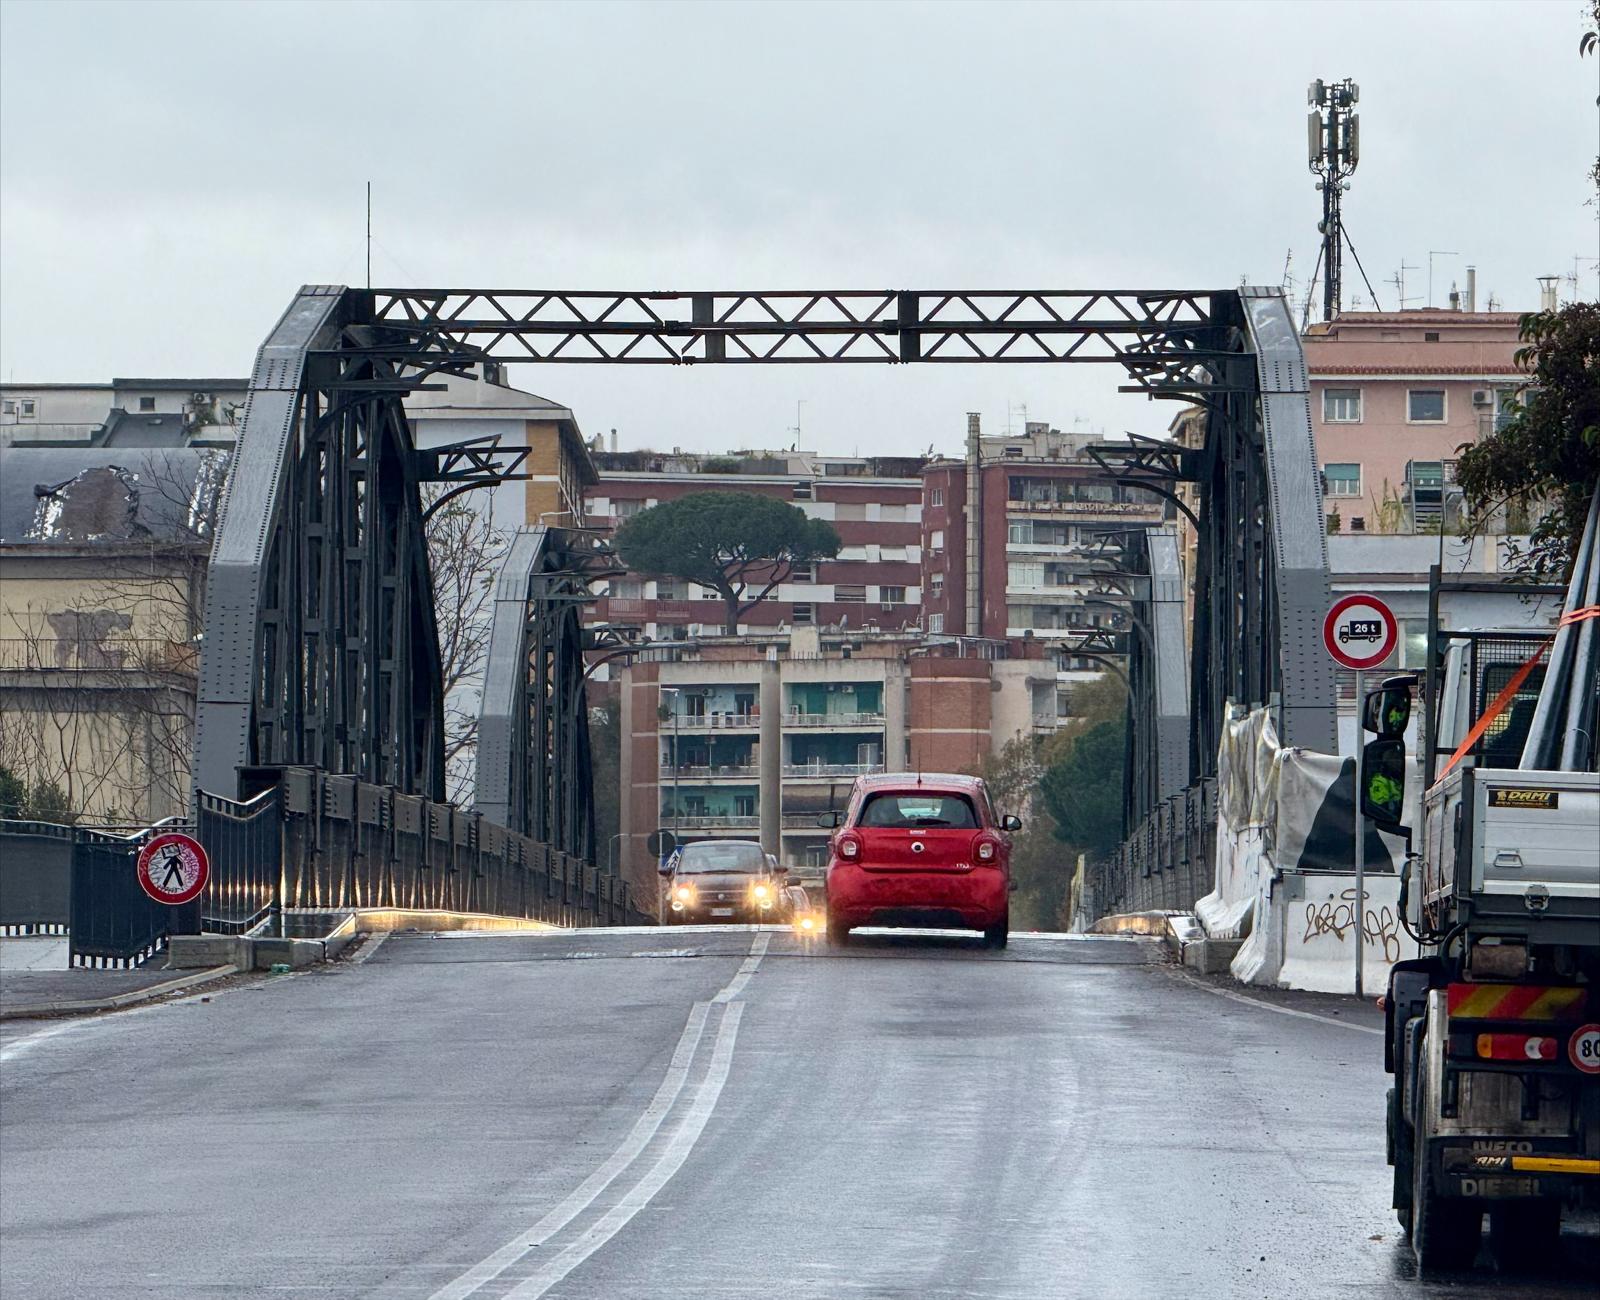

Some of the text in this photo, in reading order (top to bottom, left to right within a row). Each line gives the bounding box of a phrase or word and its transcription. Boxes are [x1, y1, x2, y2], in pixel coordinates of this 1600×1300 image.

[1354, 624, 1376, 632] 26 t
[1472, 1140, 1534, 1153] IVECO
[1461, 1178, 1544, 1198] DIESEL
